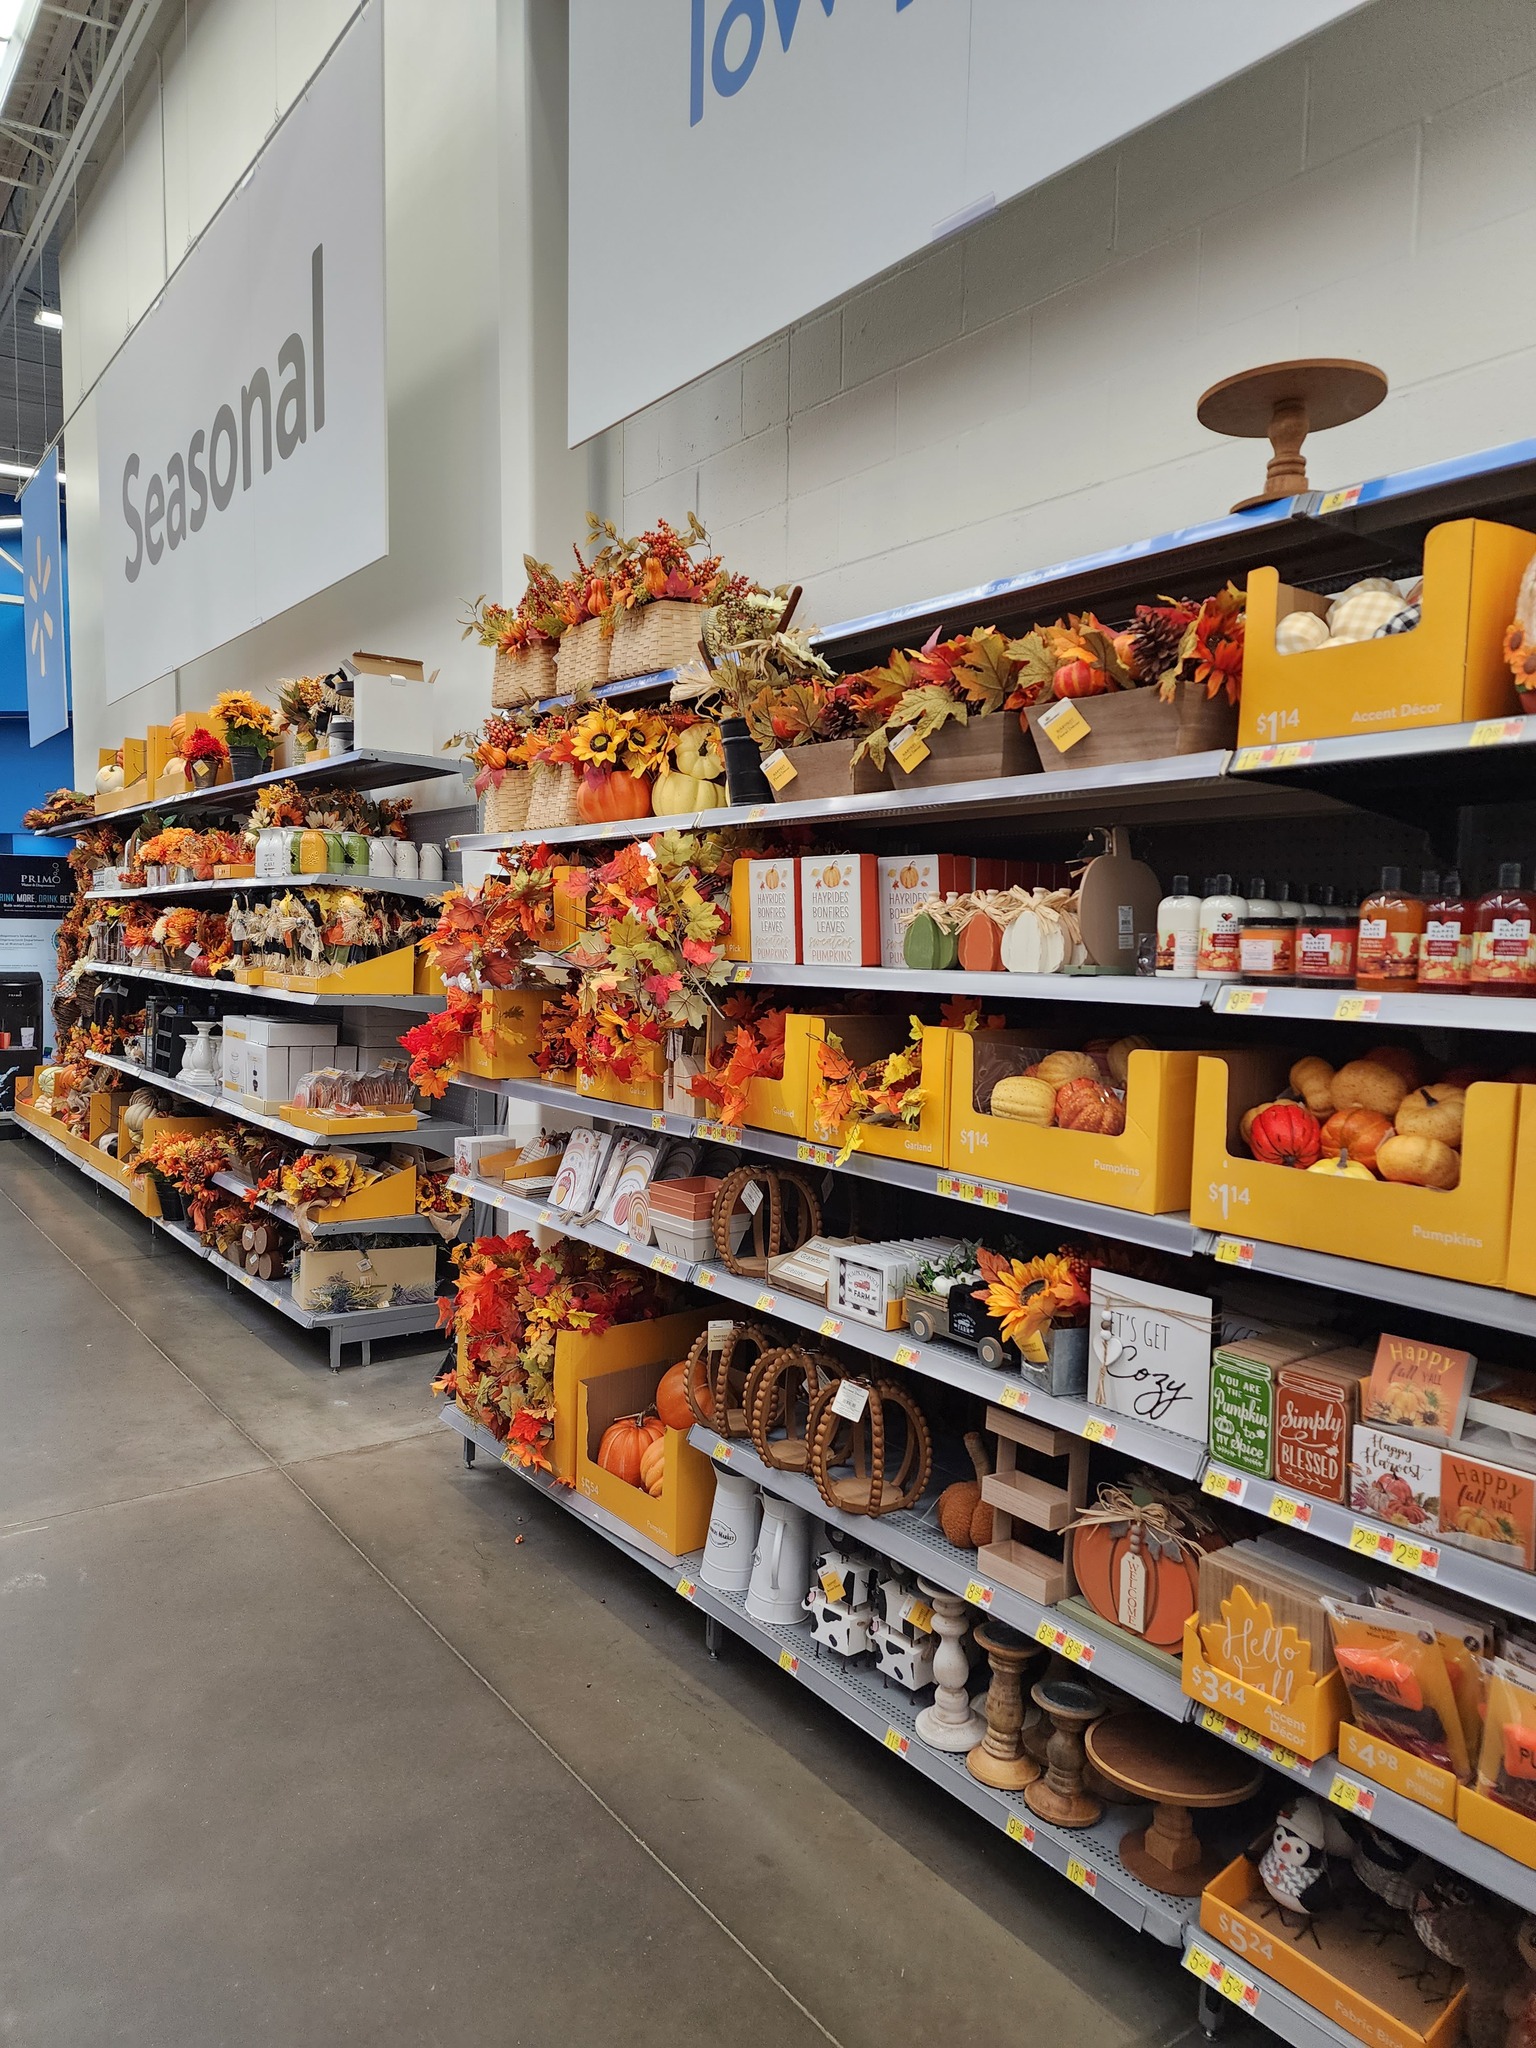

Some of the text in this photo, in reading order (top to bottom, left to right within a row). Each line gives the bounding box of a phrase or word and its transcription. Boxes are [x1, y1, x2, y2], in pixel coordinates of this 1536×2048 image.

[123, 243, 325, 583] Seasonal
[1351, 702, 1443, 723] Accent Décor
[21, 874, 61, 884] PRIMO
[38, 894, 58, 903] DRINK
[757, 892, 786, 904] HAYRIDES
[812, 891, 849, 903] HAYRIDES
[889, 892, 928, 905] HAYRIDES
[757, 906, 786, 918] BONFIRES
[812, 906, 849, 918] BONFIRES
[761, 920, 784, 932] LEAVES
[816, 921, 845, 933] LEAVES
[729, 944, 742, 952] Pick
[757, 947, 789, 960] PUMPKINS
[811, 949, 852, 963] PUMPKINS
[772, 1106, 795, 1118] Garland
[904, 1139, 932, 1153] Garland
[1093, 1158, 1140, 1177] Pumpkins
[1411, 1224, 1483, 1248] Pumpkins
[854, 1289, 871, 1302] FARM
[1110, 1311, 1170, 1351] ET'S GET
[1389, 1343, 1456, 1373] Happy
[1106, 1345, 1193, 1420] Cozy
[1388, 1362, 1418, 1383] fall
[1219, 1373, 1261, 1395] YOU ARE
[1227, 1387, 1242, 1399] THE
[1214, 1387, 1269, 1428] Pumpkin
[1280, 1400, 1344, 1441] Simply
[1243, 1426, 1256, 1440] to
[1231, 1432, 1264, 1459] Spice
[1369, 1433, 1414, 1463] Happy
[1281, 1443, 1339, 1480] BLESSED
[1360, 1449, 1432, 1481] Harvest
[1452, 1463, 1524, 1499] Happy
[1457, 1485, 1487, 1507] fall
[646, 1519, 668, 1539] Pumpkins
[1127, 1560, 1139, 1627] WELCOME
[1222, 1616, 1301, 1670] Hello
[1343, 1666, 1402, 1699] PUMPKIN
[1264, 1705, 1306, 1734] Accent
[1270, 1720, 1306, 1747] Décor
[1416, 1766, 1446, 1789] Mini
[1406, 1778, 1445, 1804] Pillow
[1334, 1999, 1374, 2034] Fabric
